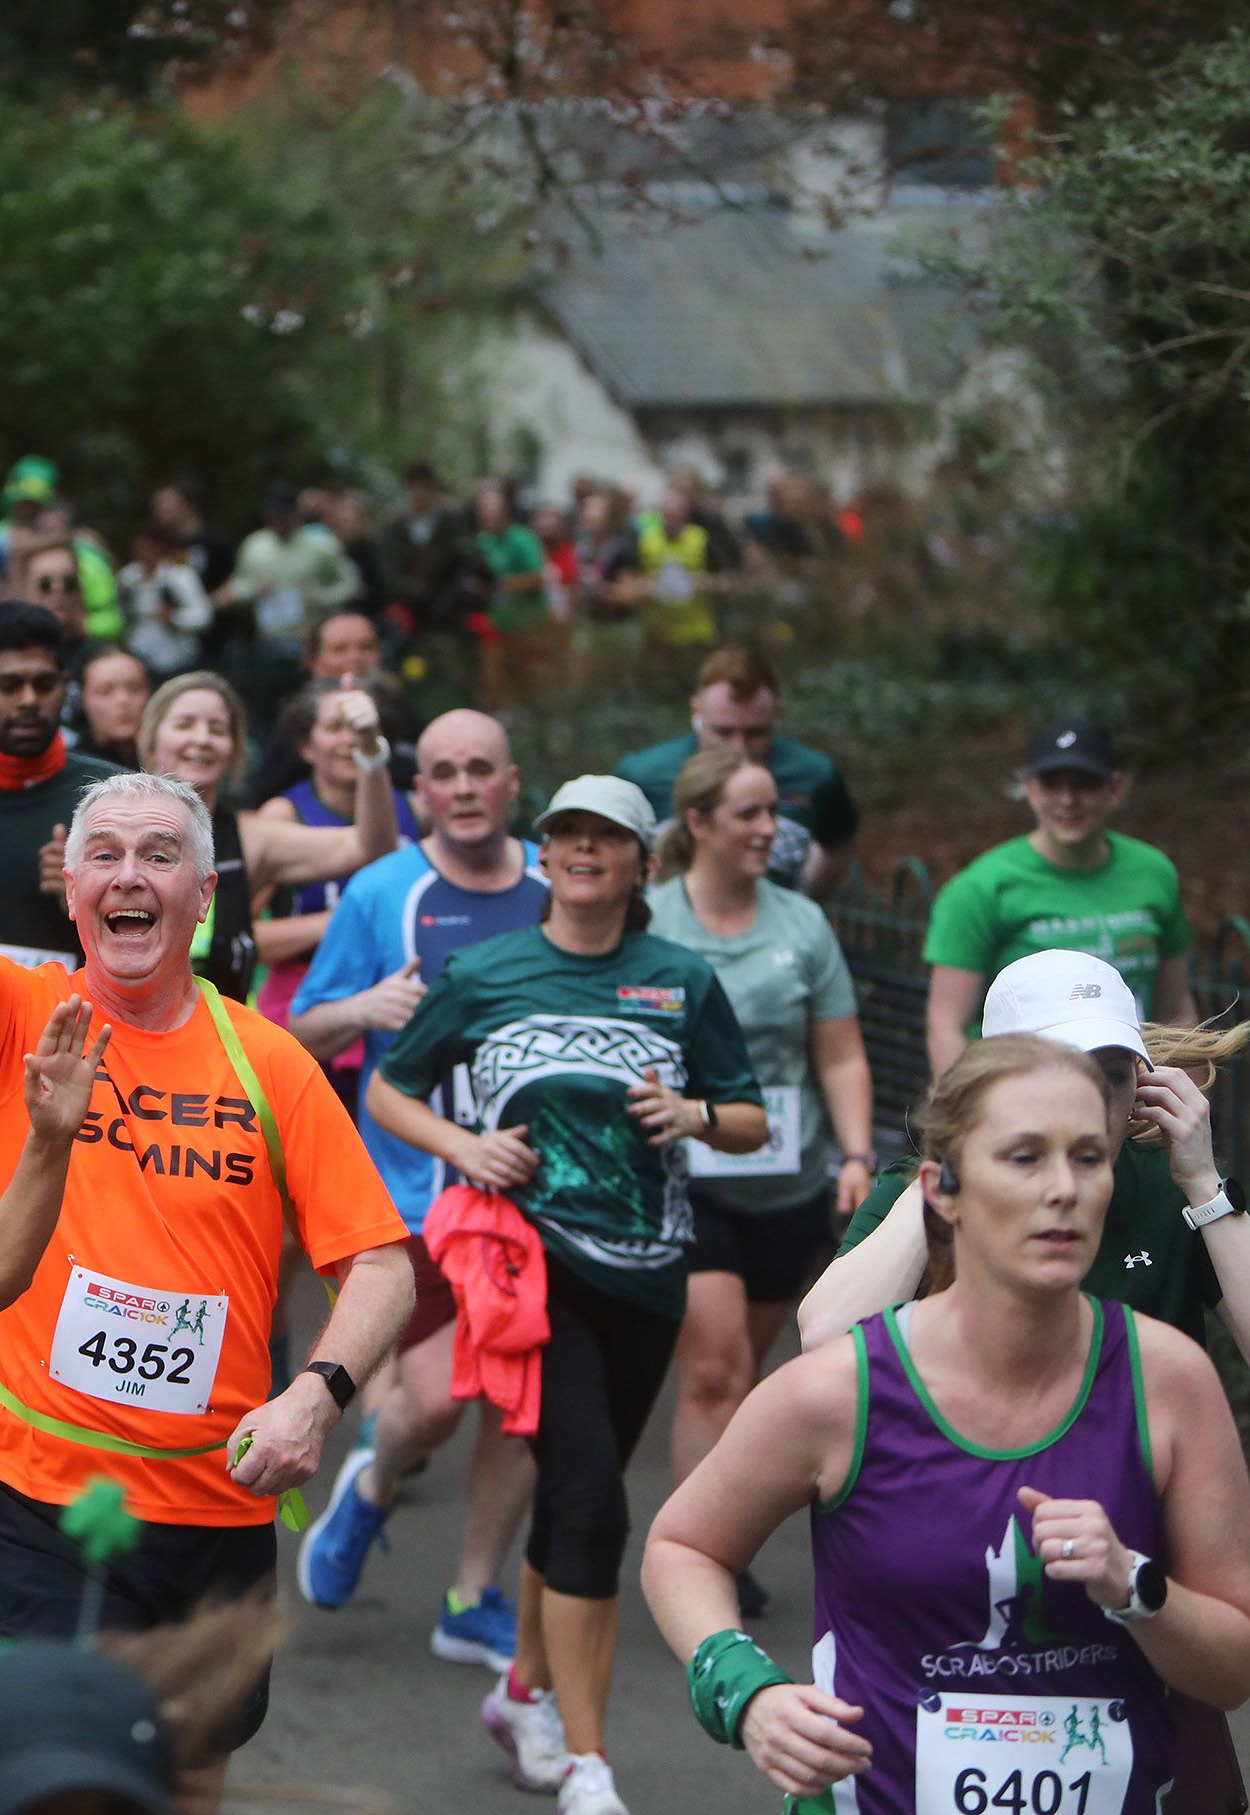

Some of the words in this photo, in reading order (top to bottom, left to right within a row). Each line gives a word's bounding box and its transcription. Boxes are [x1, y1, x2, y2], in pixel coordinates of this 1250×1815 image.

[98, 1287, 154, 1310] SPAR
[78, 1331, 195, 1385] 4352
[115, 1379, 146, 1397] JIM
[960, 1709, 1037, 1726] SPAR
[953, 1767, 1093, 1815] 6401
